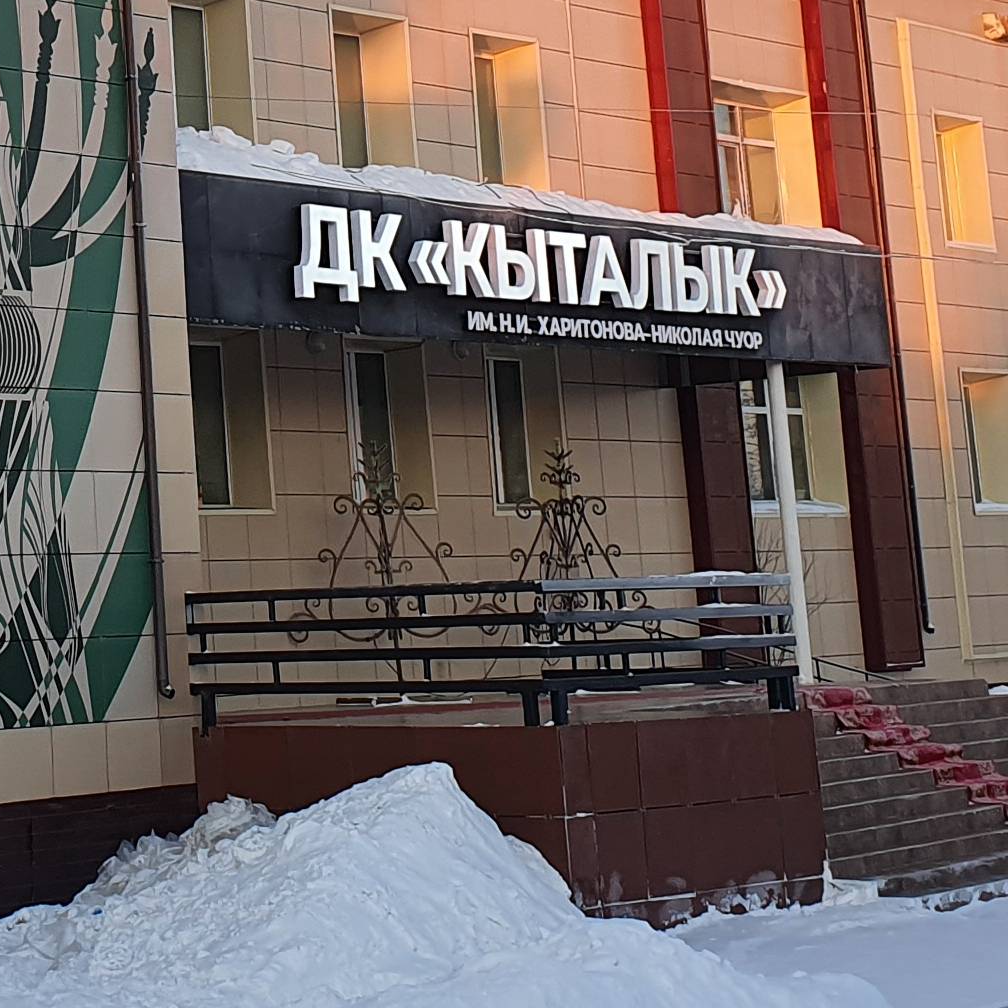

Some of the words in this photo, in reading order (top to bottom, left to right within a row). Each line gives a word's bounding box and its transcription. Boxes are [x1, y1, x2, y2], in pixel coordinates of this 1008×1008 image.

[294, 203, 407, 302] ДК
[408, 219, 787, 316] «КЫТАЛЫК»
[467, 310, 498, 332] ИМ.
[499, 312, 533, 335] Н.И.
[724, 329, 763, 350] ЧУОР
